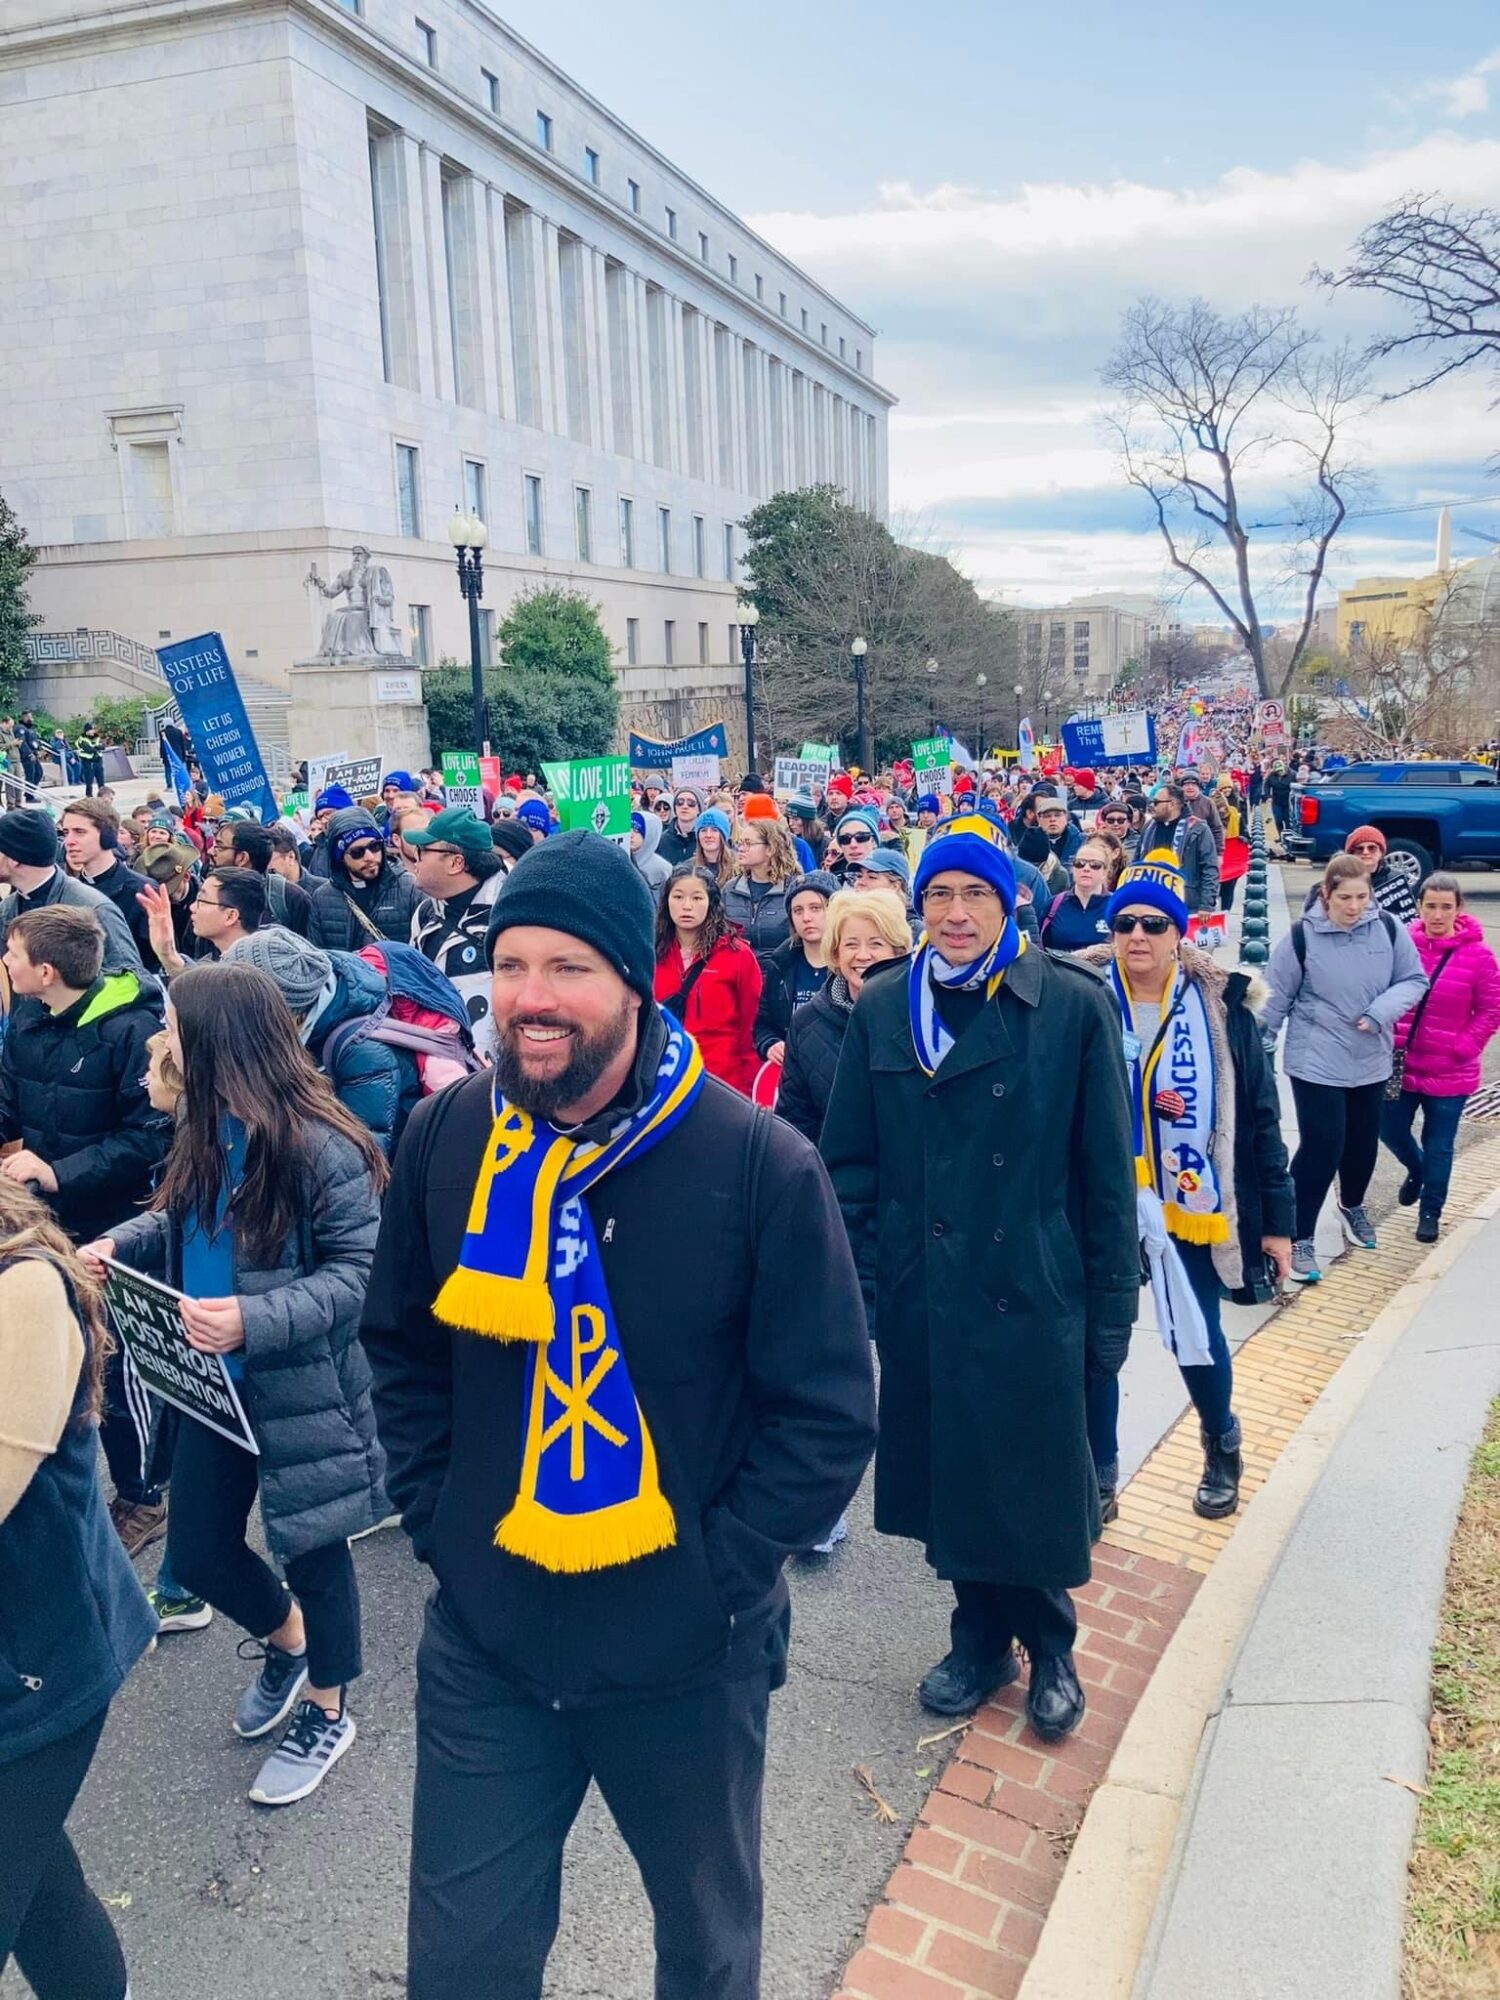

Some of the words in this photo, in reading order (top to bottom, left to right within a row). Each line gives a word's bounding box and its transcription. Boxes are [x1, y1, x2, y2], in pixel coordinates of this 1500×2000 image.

[165, 648, 222, 678] SISTERS
[174, 676, 195, 694] OF
[196, 666, 227, 687] LIFE
[203, 716, 221, 732] LET
[220, 712, 233, 726] US
[1076, 724, 1104, 736] REME
[205, 728, 241, 750] CHERISH
[913, 742, 930, 757] LOVE
[931, 740, 944, 754] LIFE
[1078, 737, 1098, 746] The
[213, 745, 246, 766] WOMEN
[647, 748, 673, 757] JOHN
[674, 742, 697, 754] PAUL
[217, 771, 229, 784] IN
[229, 761, 253, 780] THEIR
[336, 769, 353, 778] AM
[357, 764, 377, 773] THE
[443, 755, 460, 770] LOVE
[461, 755, 477, 769] LIFE
[778, 761, 808, 772] LEAD
[808, 763, 827, 773] ON
[573, 766, 602, 802] LOVE
[606, 763, 629, 797] LIFE
[920, 767, 946, 783] CHOOSE
[343, 781, 377, 794] RATION
[448, 788, 478, 802] CHOOSE
[1124, 867, 1178, 892] VENICE
[1374, 878, 1405, 898] eace
[1382, 888, 1409, 907] gins
[1171, 1021, 1197, 1129] DIOCESE
[122, 1288, 155, 1323] AM
[156, 1306, 190, 1338] TH
[113, 1305, 224, 1387] POST-ROE
[130, 1342, 237, 1419] GENERATION
